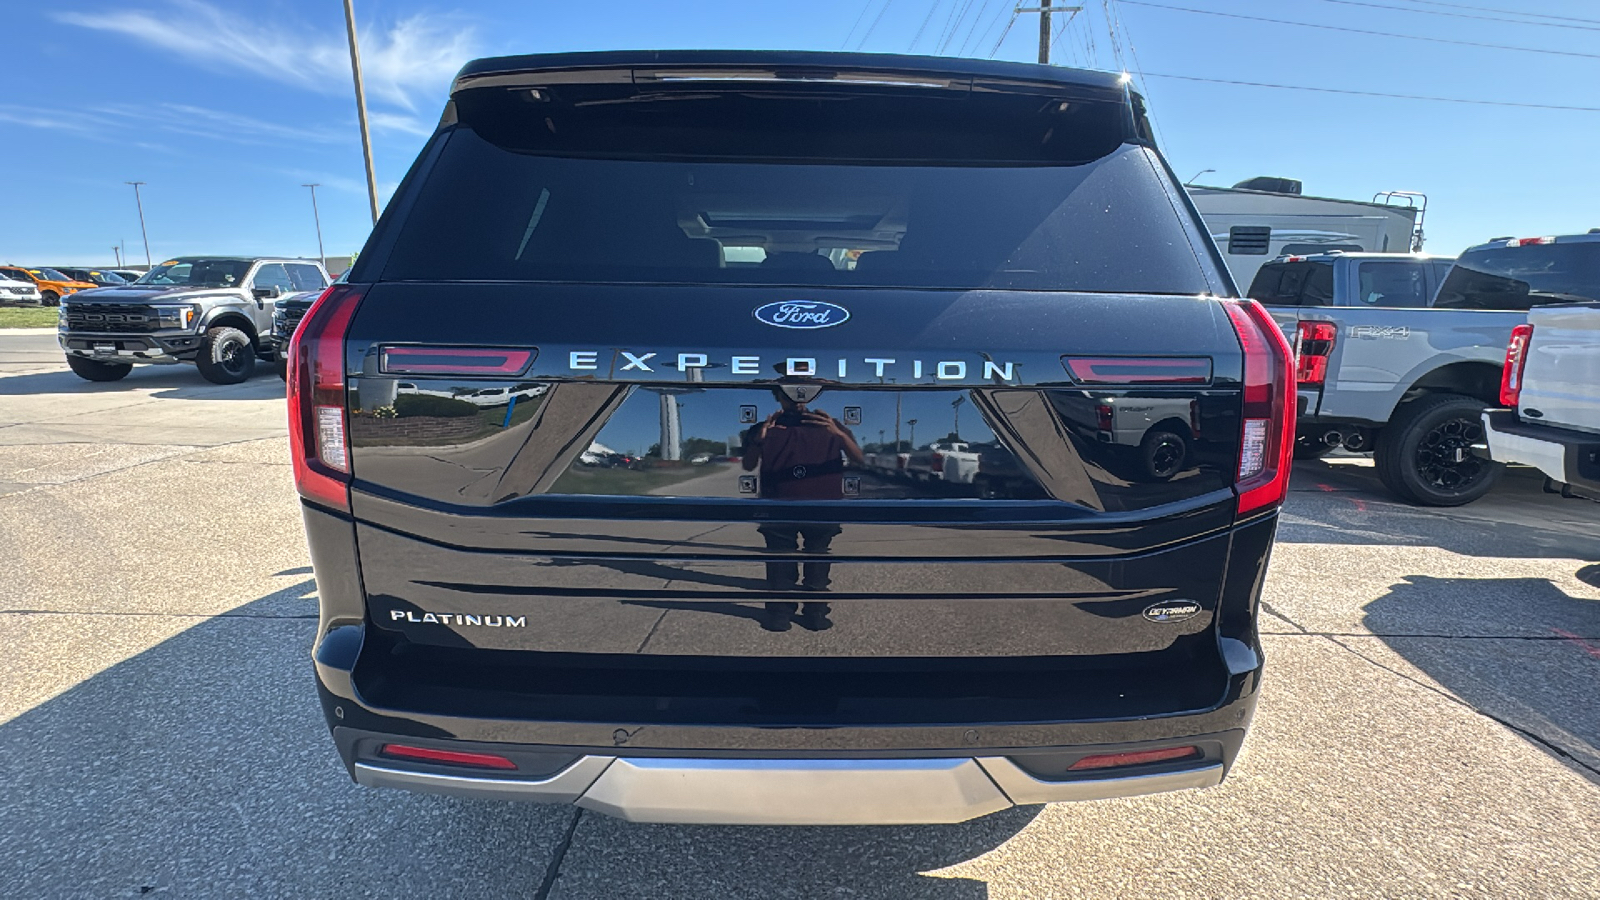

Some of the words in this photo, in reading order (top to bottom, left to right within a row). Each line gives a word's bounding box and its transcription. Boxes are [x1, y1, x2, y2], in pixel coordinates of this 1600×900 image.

[774, 302, 832, 325] Ford
[1351, 325, 1410, 338] FX4
[568, 350, 1016, 381] EXPEDITION
[390, 609, 527, 628] PLATINUM
